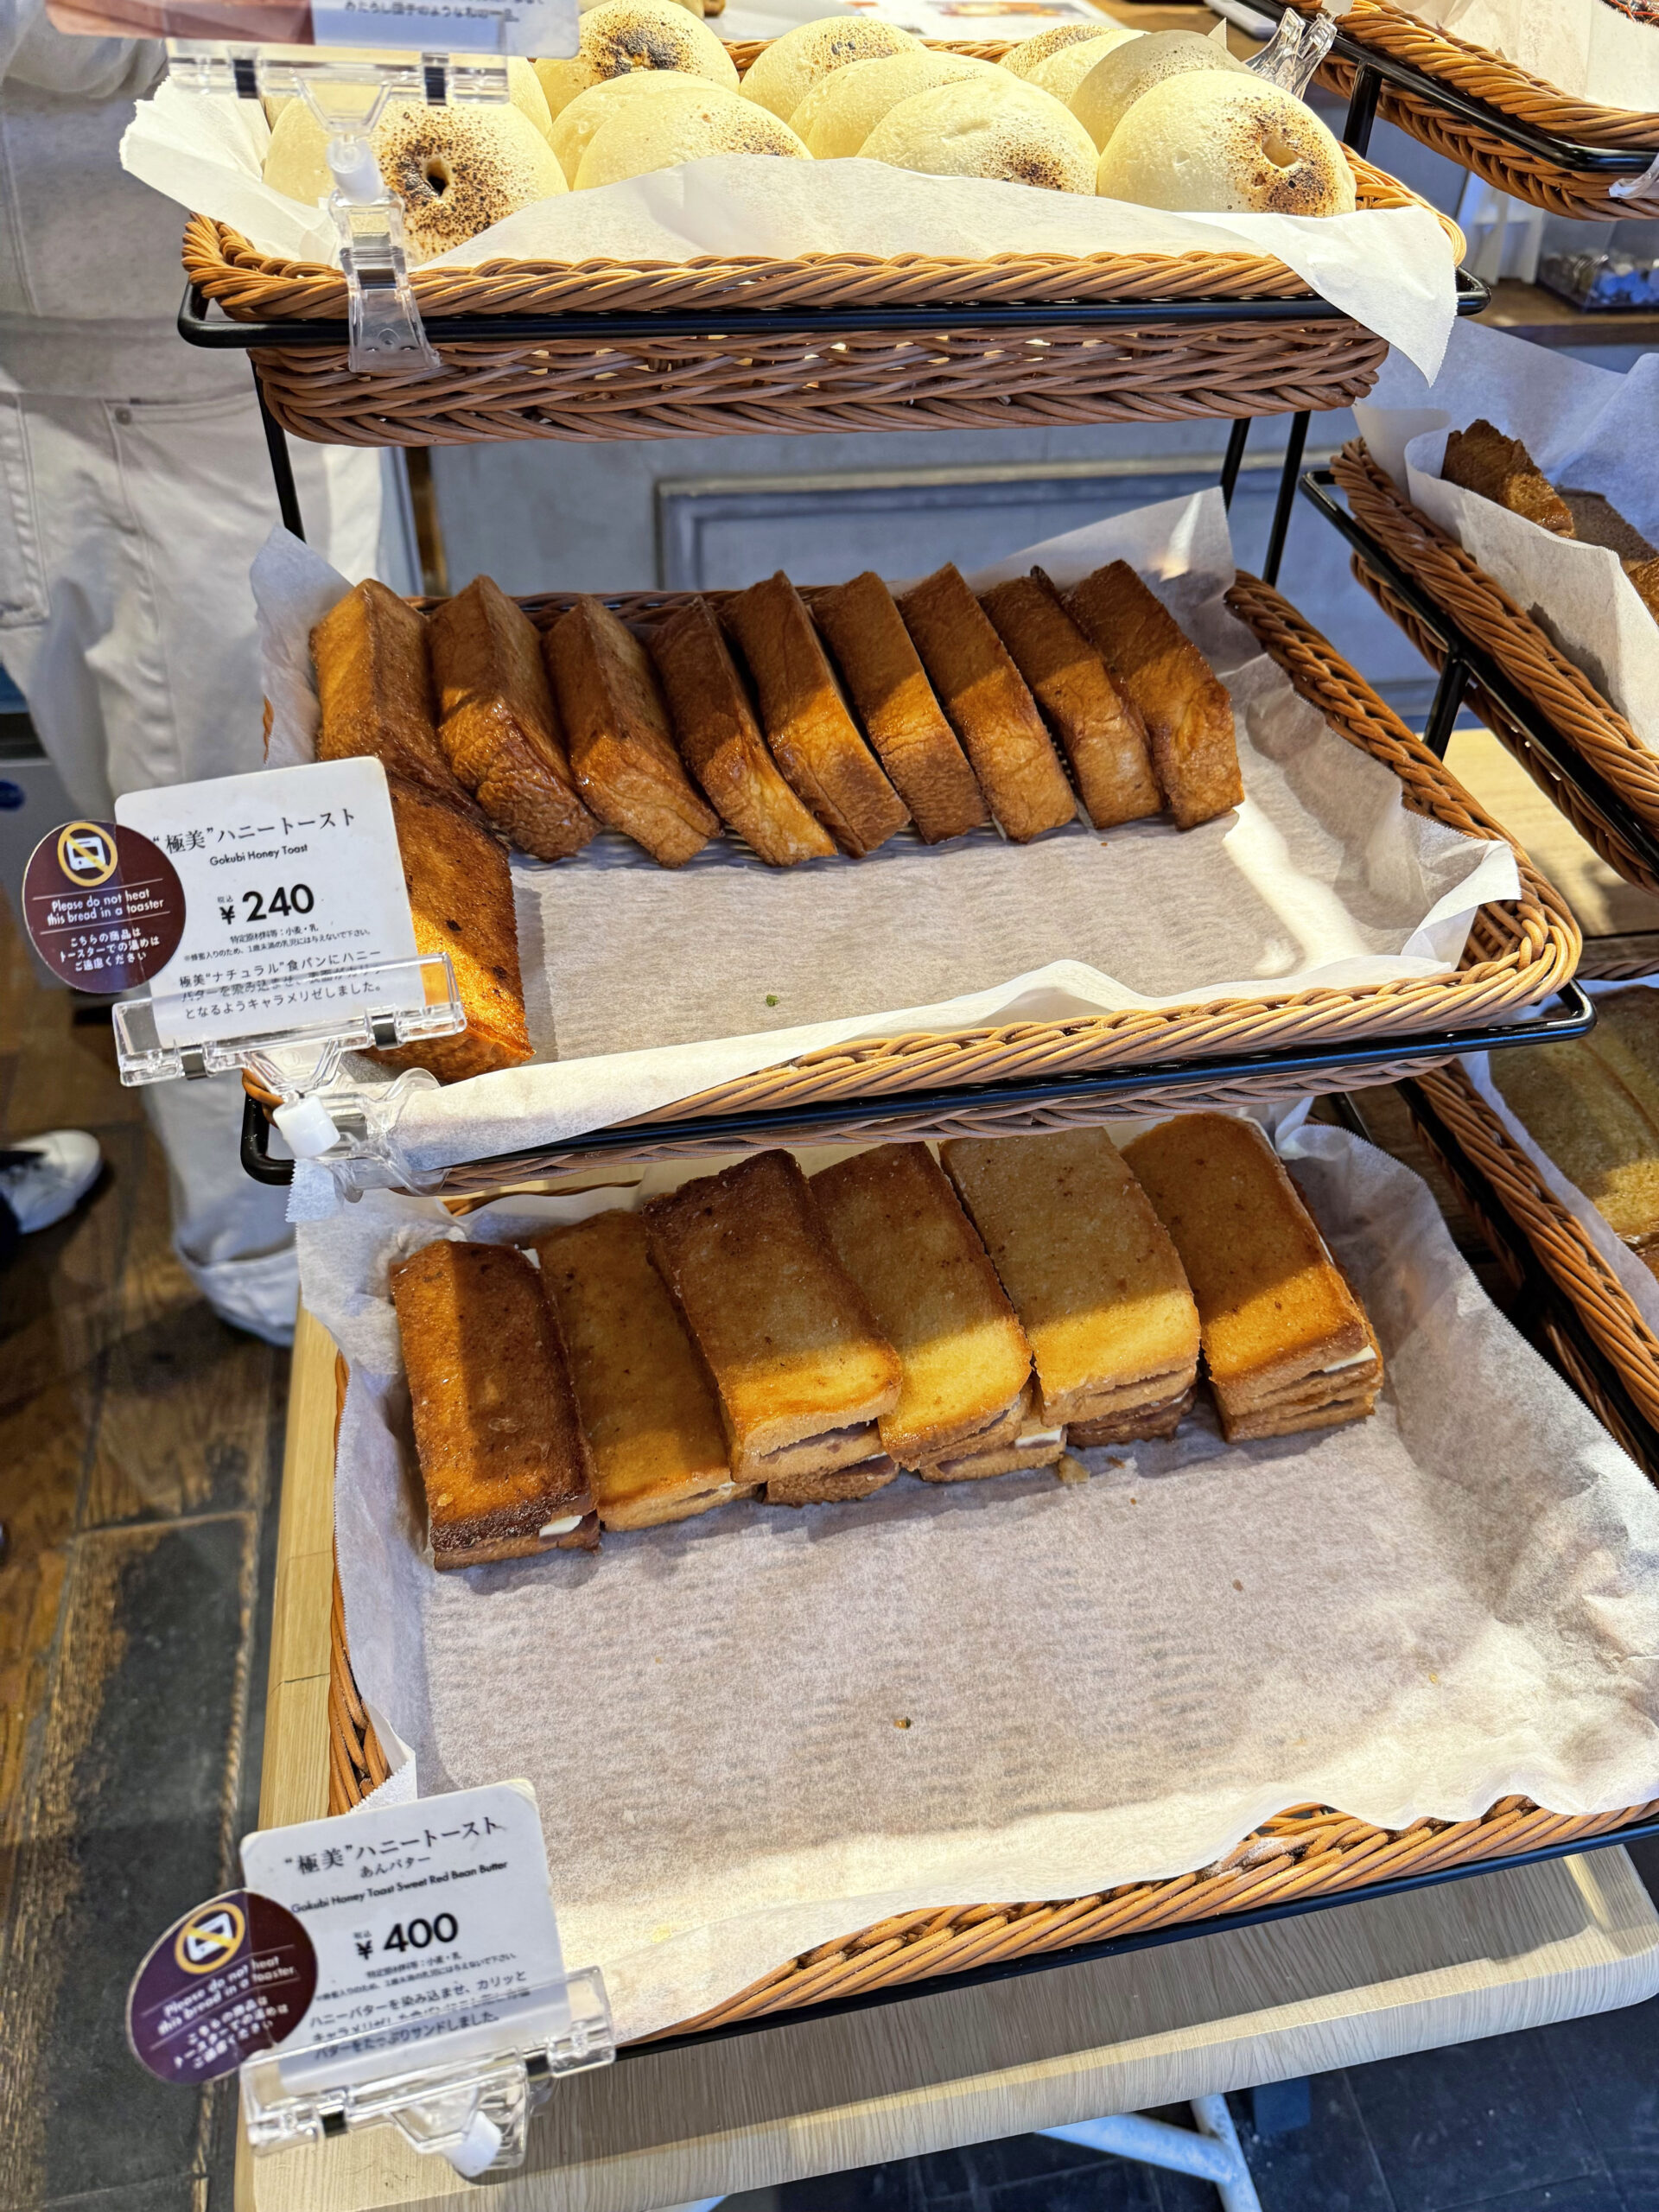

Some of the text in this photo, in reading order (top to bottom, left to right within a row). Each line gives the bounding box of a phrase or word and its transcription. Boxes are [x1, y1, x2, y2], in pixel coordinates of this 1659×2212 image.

[210, 843, 308, 867] Gokubi Honey Toast
[47, 913, 66, 926] this
[67, 909, 98, 924] bread
[100, 907, 111, 918] in
[126, 899, 164, 914] toaster
[51, 888, 150, 913] Please do not heat
[60, 936, 160, 963] トースターでの温めは
[70, 927, 141, 948] こちらの商品は
[74, 951, 147, 972] ご遠慮ください
[359, 1856, 431, 1878] あんバター
[290, 1860, 508, 1914] Gokubi Honey Toast Sweet Red Bean Butter
[163, 1988, 206, 2018] Please
[227, 1964, 249, 1982] not
[251, 1956, 279, 1971] heat
[183, 1989, 222, 2019] bread
[251, 1966, 296, 1982] toaster
